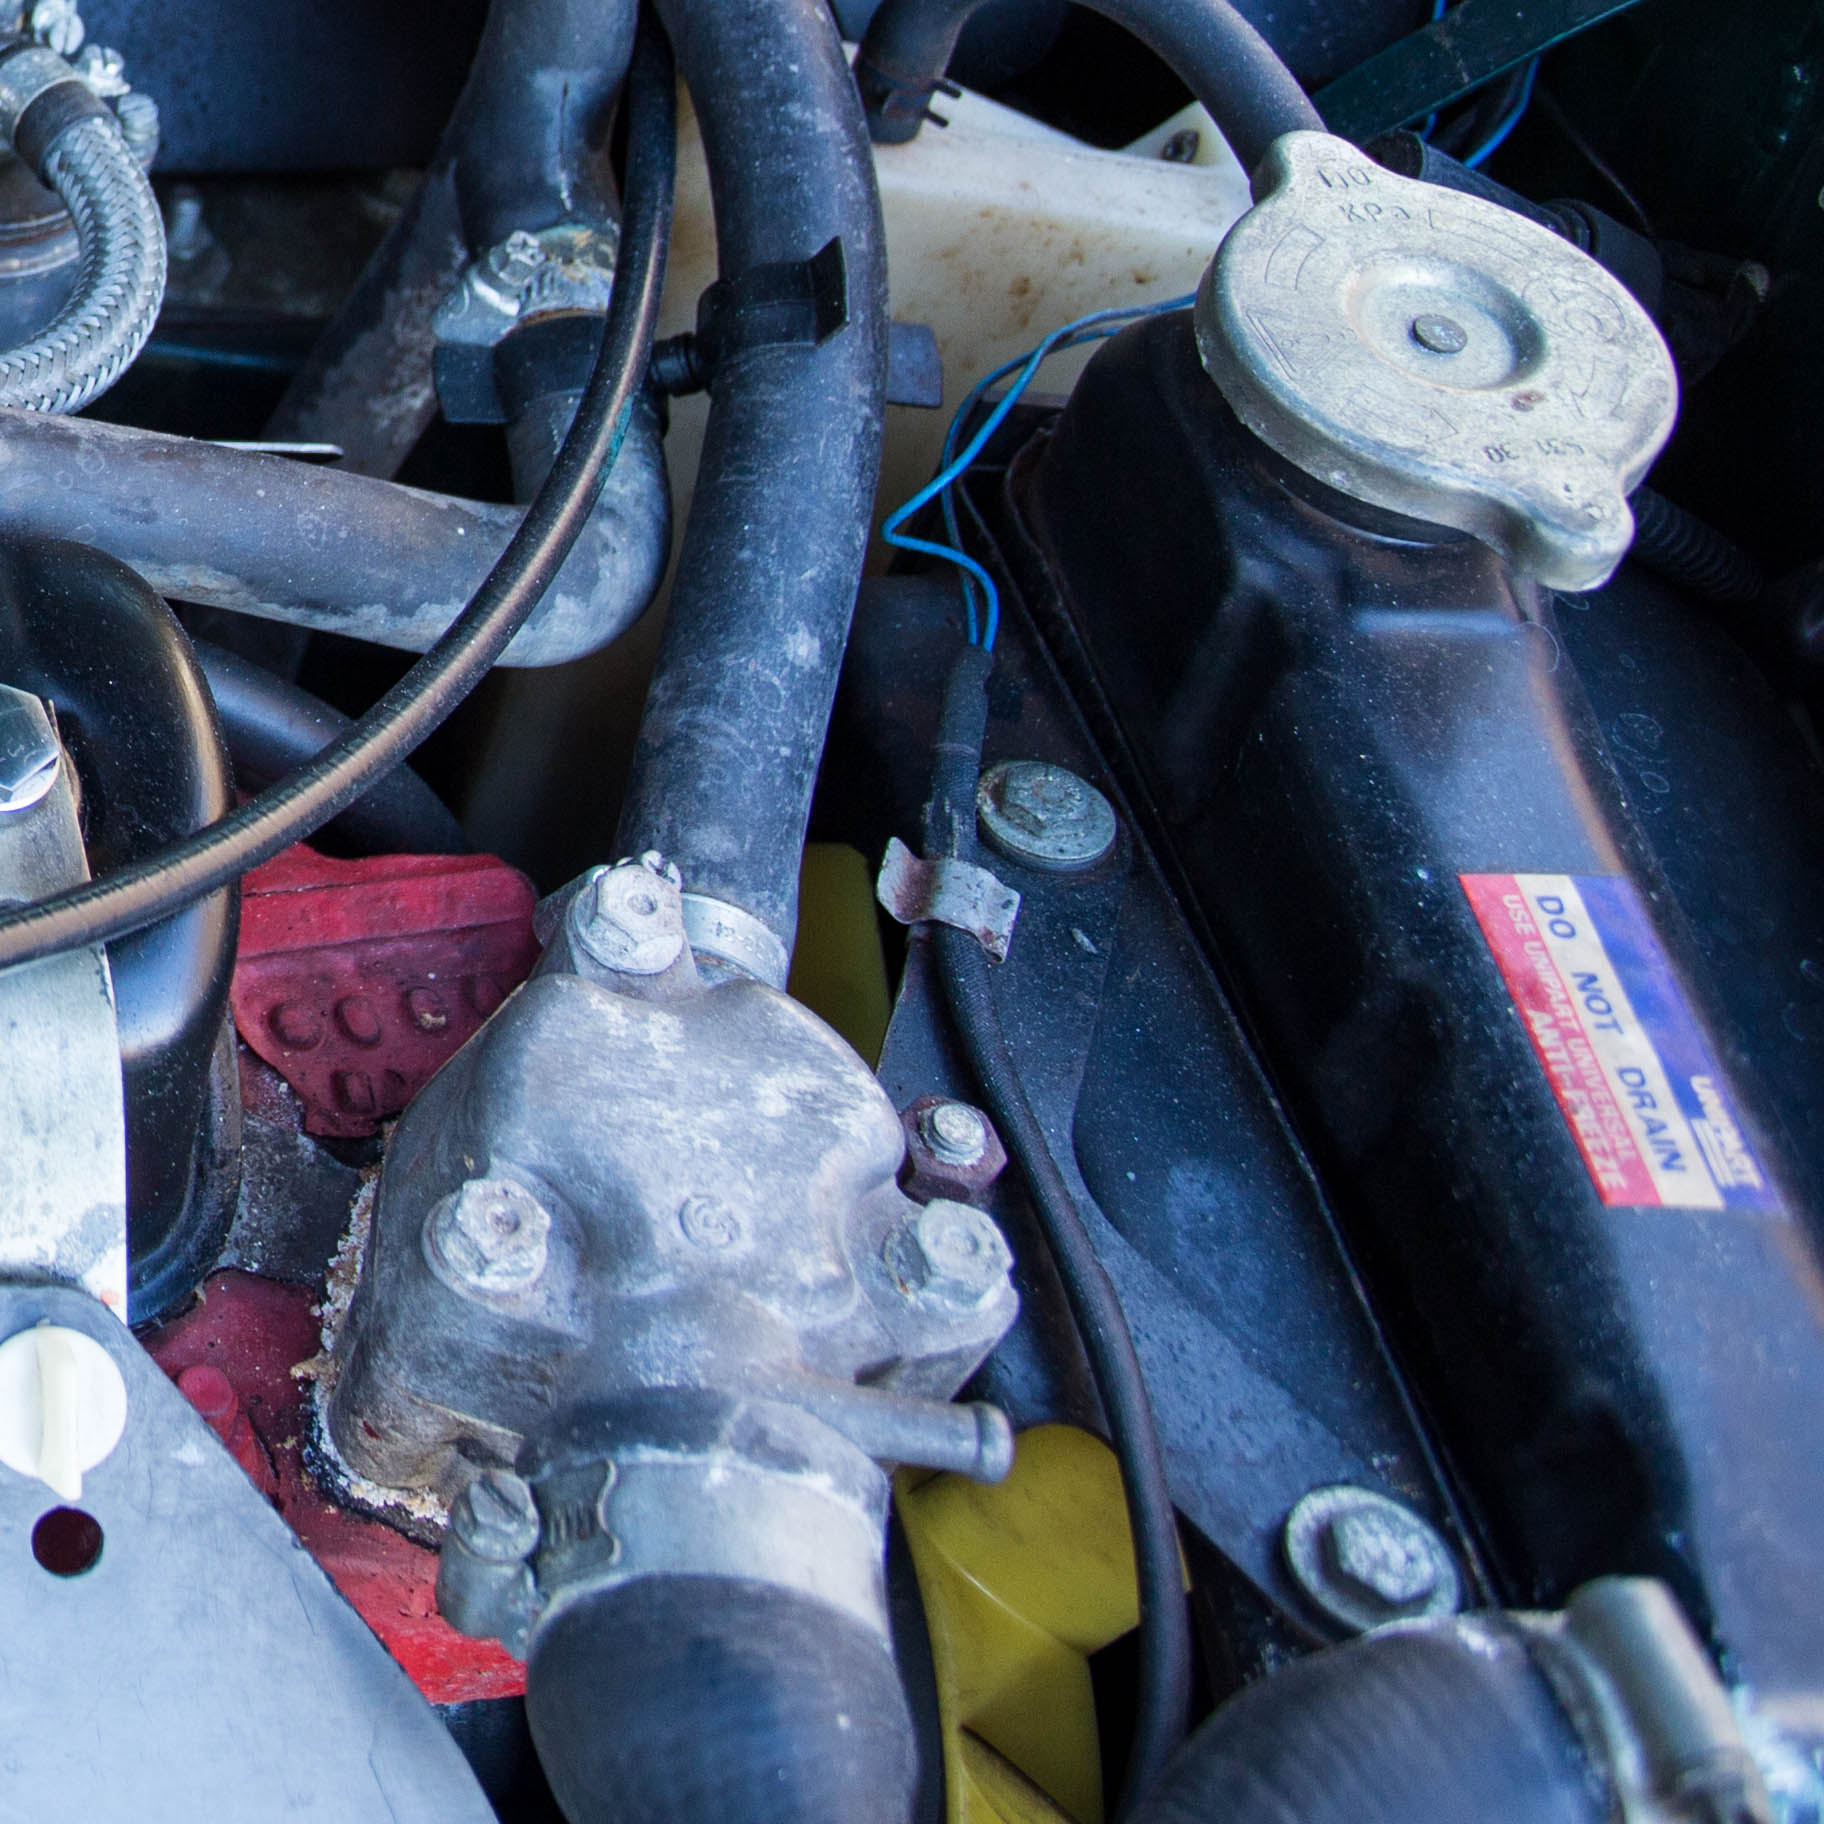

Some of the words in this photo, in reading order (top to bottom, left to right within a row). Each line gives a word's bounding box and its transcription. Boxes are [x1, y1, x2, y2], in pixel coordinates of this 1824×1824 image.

[1502, 893, 1536, 936] USE
[1523, 941, 1579, 1032] UNIPART
[1566, 1037, 1638, 1162] UNIVERSAL
[1526, 1009, 1629, 1192] ANTI-FREEZE
[1535, 894, 1577, 941] DO
[1571, 970, 1626, 1036] NOT
[1615, 1066, 1687, 1173] DRAIN
